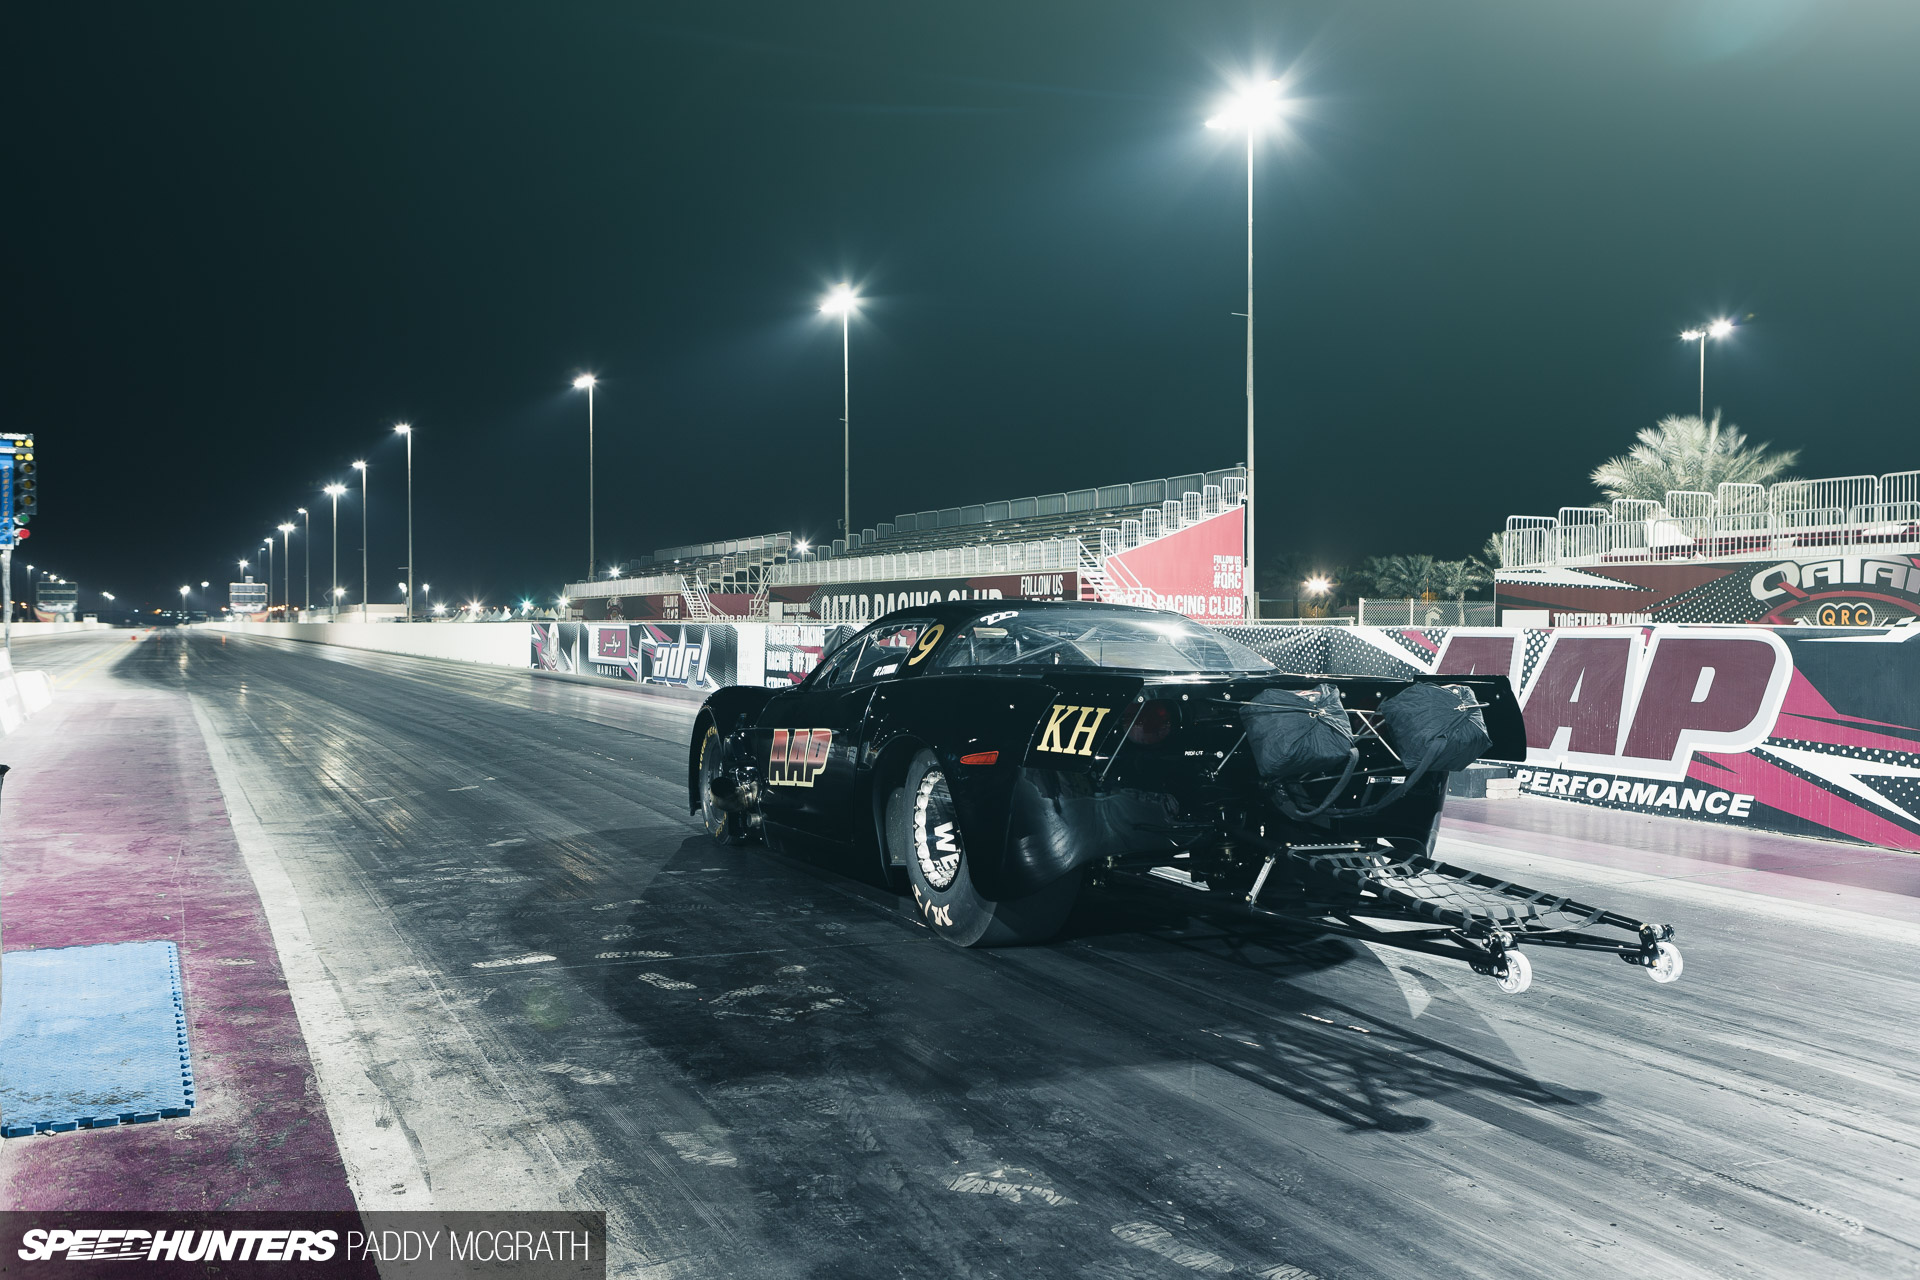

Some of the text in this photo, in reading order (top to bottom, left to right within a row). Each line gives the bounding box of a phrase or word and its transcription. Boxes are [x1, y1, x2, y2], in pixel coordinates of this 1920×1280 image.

[1213, 555, 1242, 564] FOLLOW US
[1020, 576, 1051, 596] FOLLOW
[1053, 574, 1064, 595] US
[1213, 572, 1242, 589] #QRC
[1157, 594, 1206, 615] RACING
[1208, 595, 1242, 616] CLUB
[1553, 612, 1608, 628] TOGETHER
[1822, 608, 1869, 626] QRC
[908, 624, 945, 666] 9
[1036, 704, 1111, 756] KH
[769, 728, 833, 787] AAP
[1515, 769, 1755, 818] PERFORMANCE
